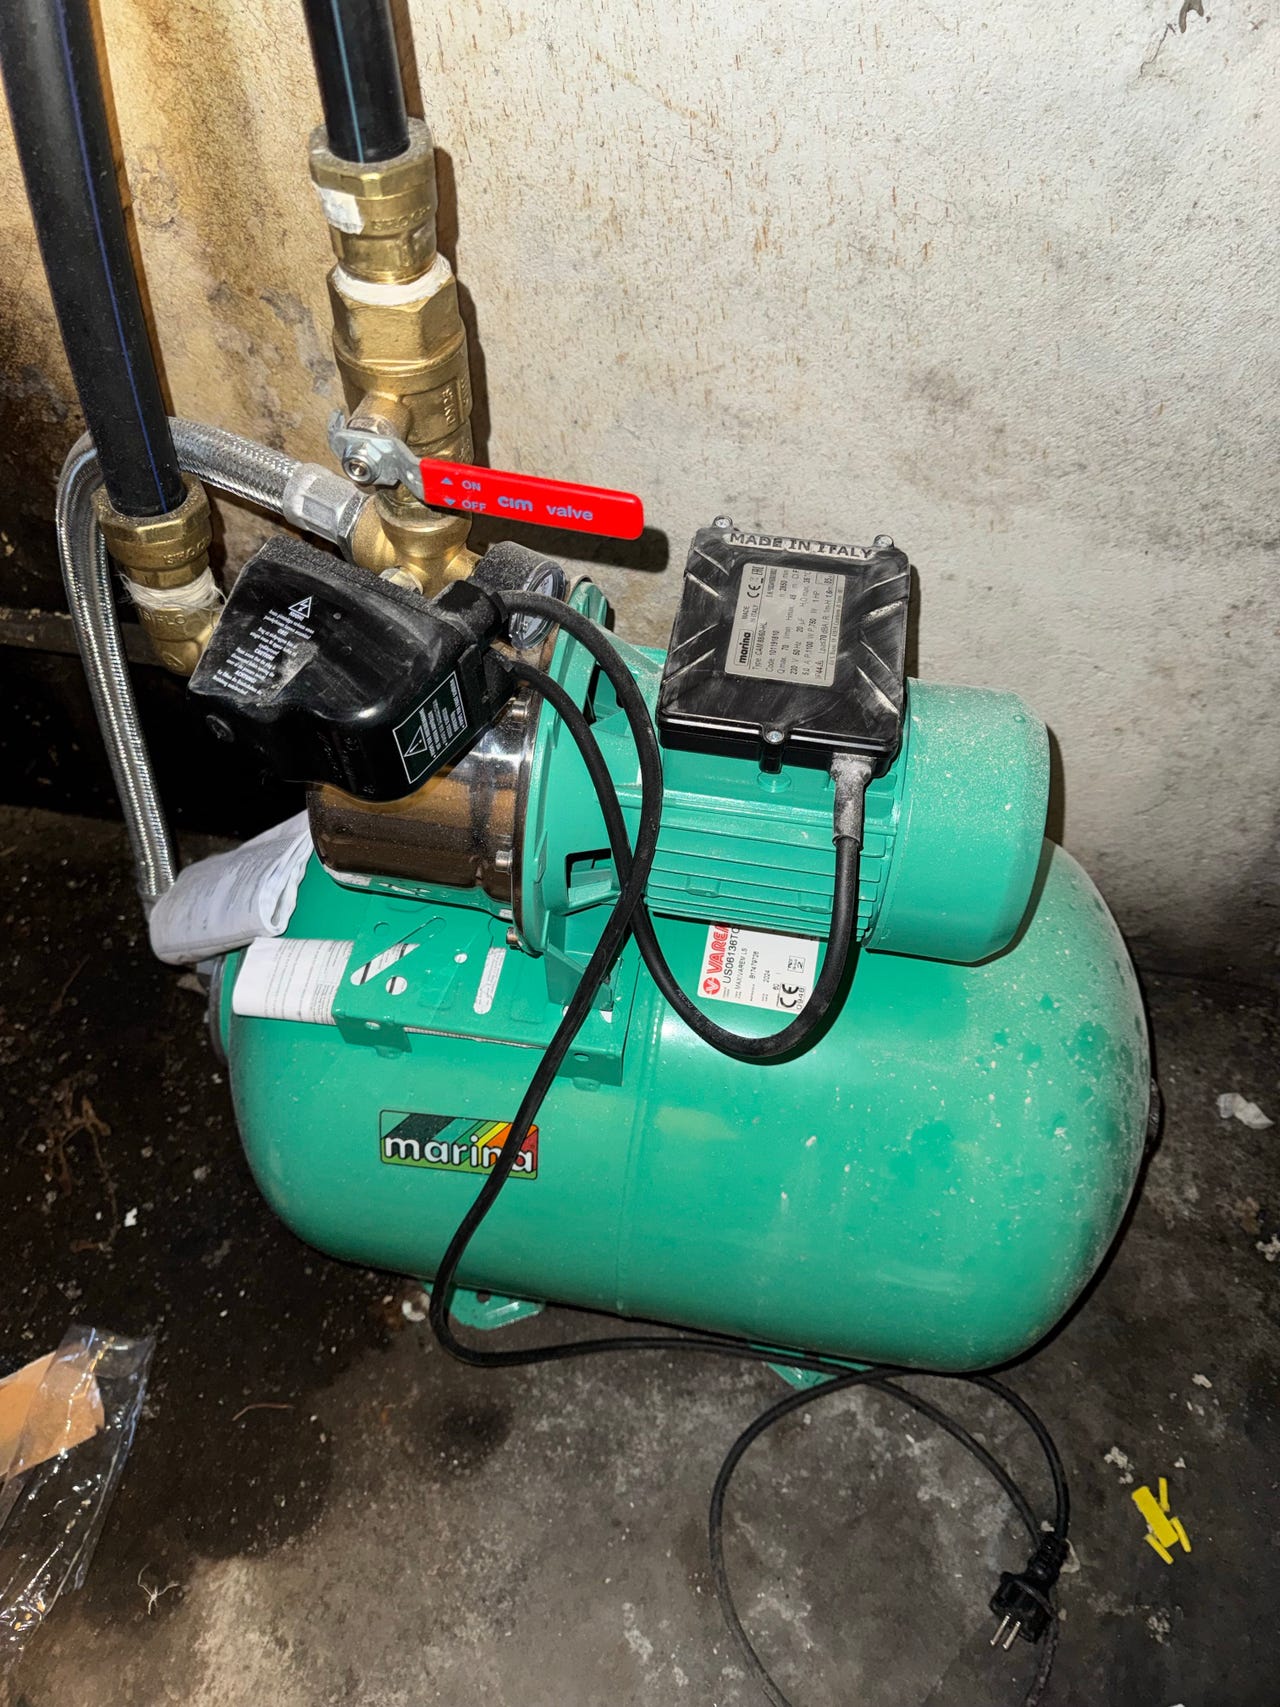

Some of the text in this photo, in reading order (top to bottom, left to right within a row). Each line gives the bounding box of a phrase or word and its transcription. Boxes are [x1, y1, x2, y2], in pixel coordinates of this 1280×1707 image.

[462, 480, 481, 491] ON
[461, 500, 487, 511] OFF
[546, 503, 593, 521] valve
[730, 533, 873, 559] MADE IN ITALY
[738, 631, 751, 664] marina
